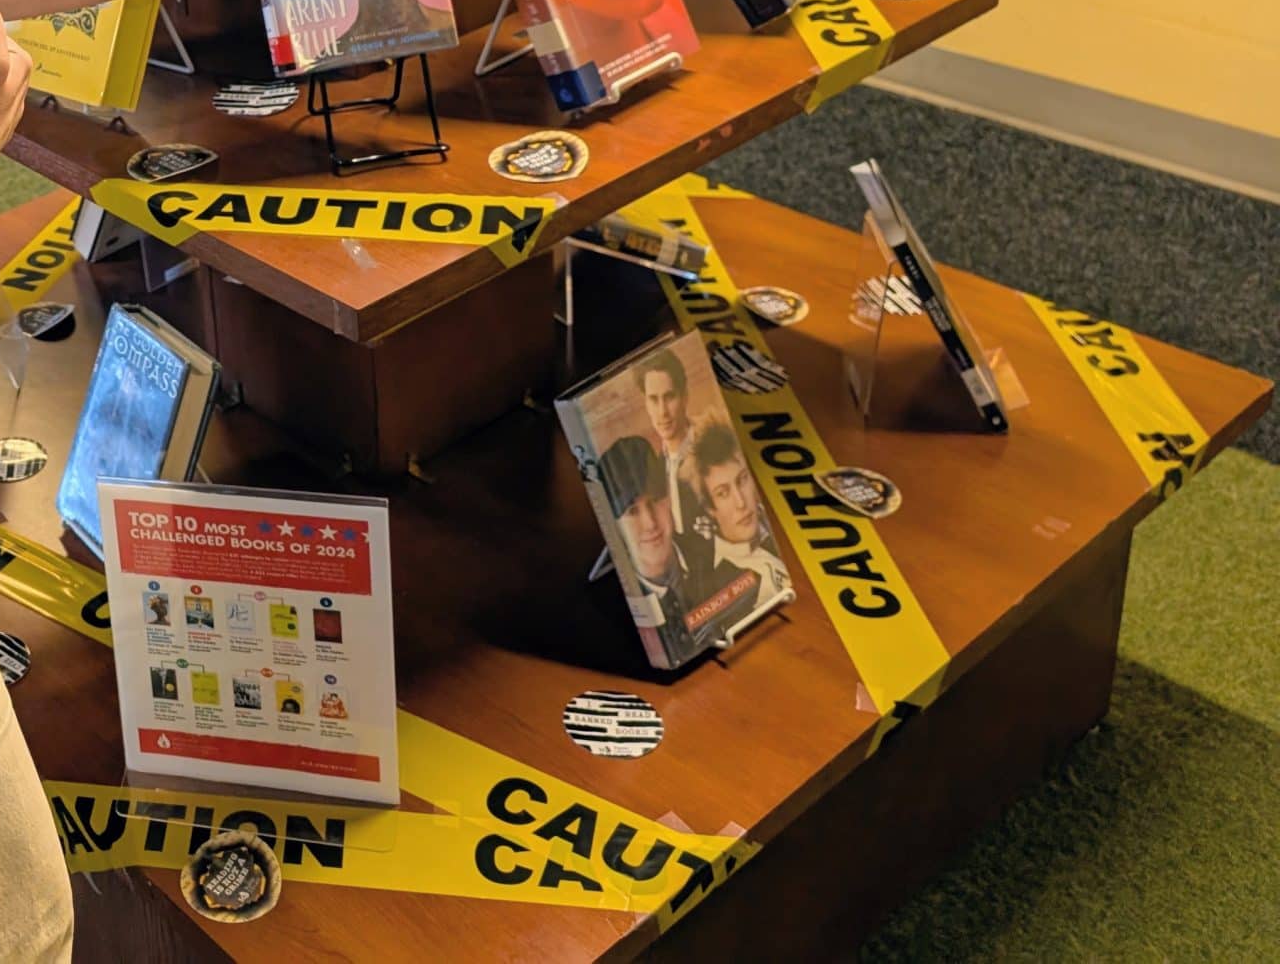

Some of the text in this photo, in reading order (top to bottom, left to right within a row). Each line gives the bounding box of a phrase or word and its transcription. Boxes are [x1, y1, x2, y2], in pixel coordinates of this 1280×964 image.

[289, 26, 345, 66] BLUE
[147, 189, 545, 254] CAUTION
[132, 332, 184, 379] GOLDEN
[128, 511, 247, 537] TOP 10 MOST
[740, 412, 902, 619] CAUTION
[130, 528, 357, 560] CHALLENGED BOOKS OF 2024
[574, 715, 613, 726] BANNED
[615, 727, 649, 736] BOOKS
[624, 710, 652, 719] READ
[51, 795, 346, 869] AUTION
[206, 852, 239, 891] READING
[213, 857, 247, 896] IS NOT A
[224, 867, 250, 896] CRIME
